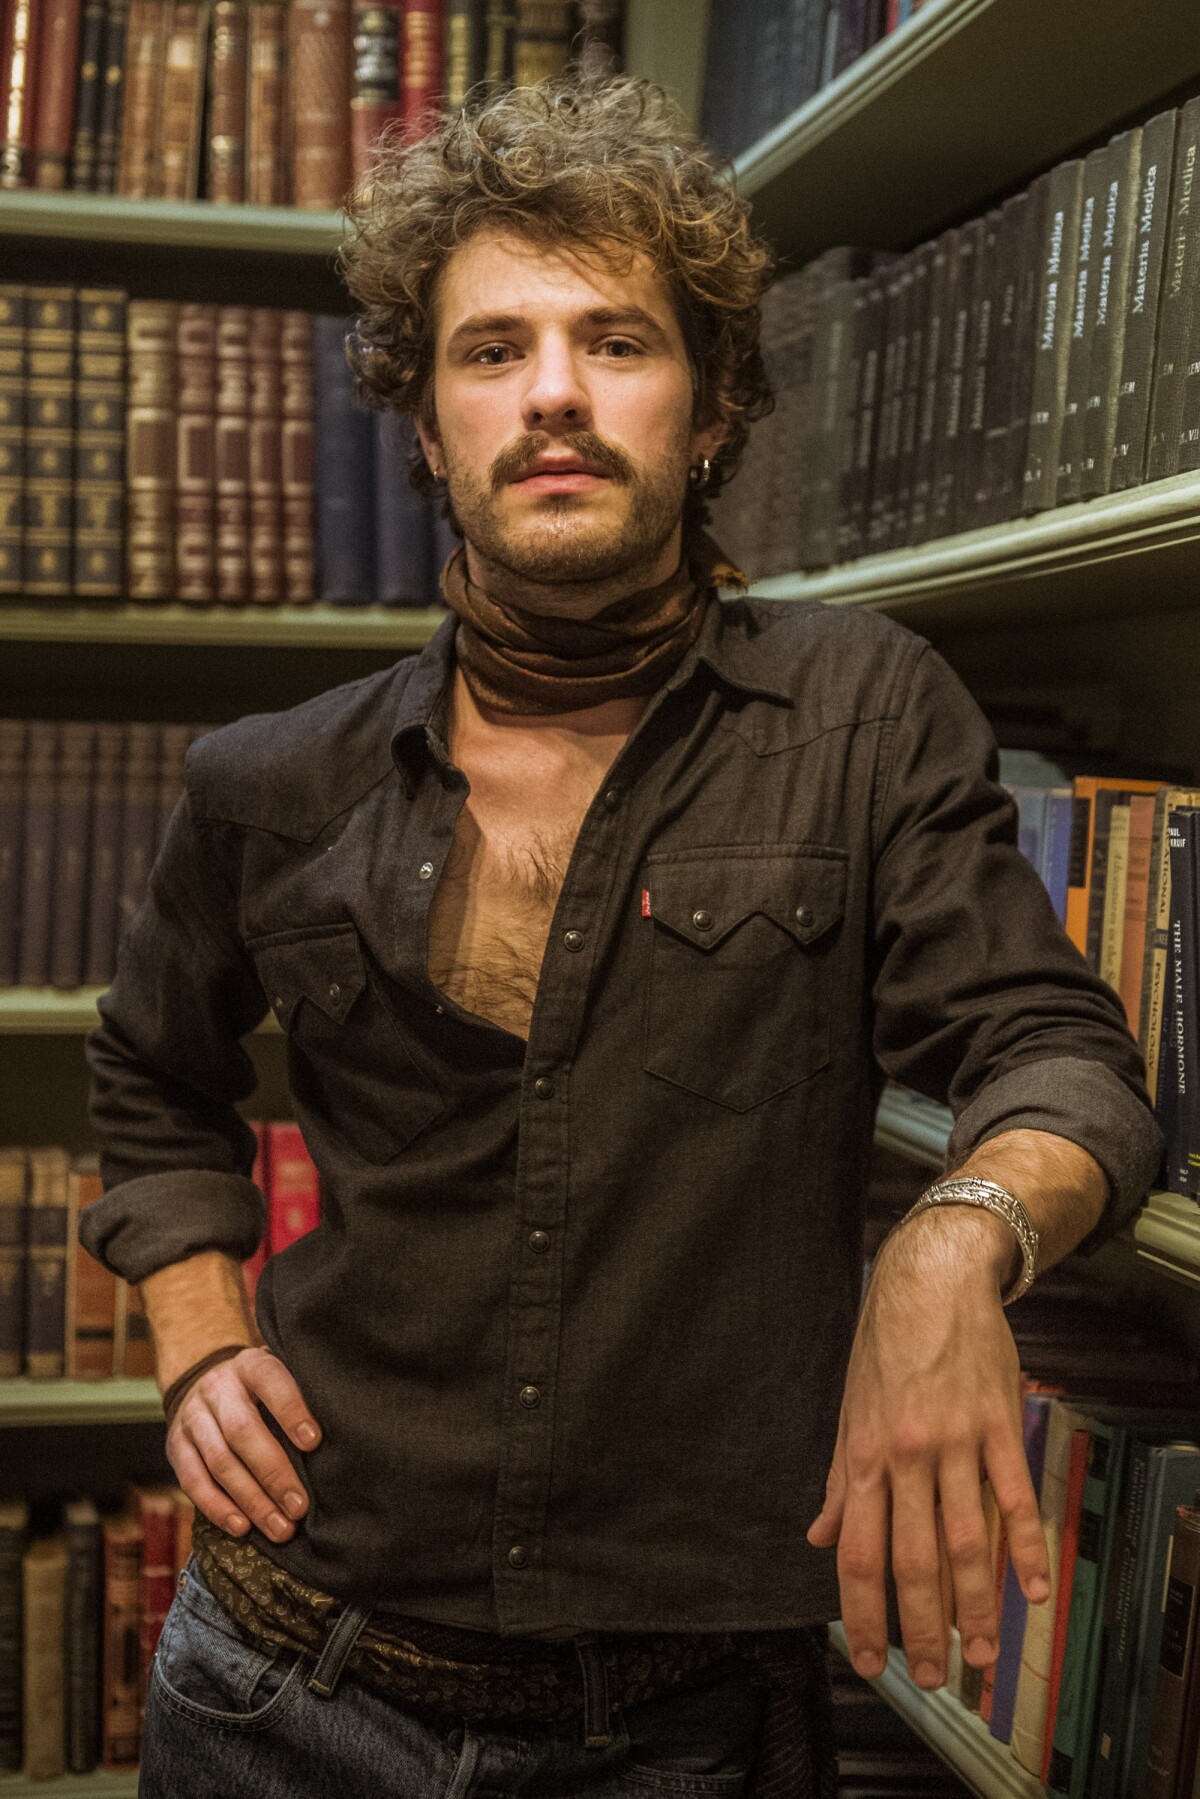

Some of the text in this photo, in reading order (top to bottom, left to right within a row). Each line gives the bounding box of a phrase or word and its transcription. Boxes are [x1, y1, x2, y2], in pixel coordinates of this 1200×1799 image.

[1132, 164, 1158, 314] Materia Medica
[1178, 144, 1197, 217] Medica
[1041, 211, 1064, 351] Materia Medica
[1073, 196, 1095, 339] Materia Medica
[1096, 181, 1119, 326] Materia Medica
[1148, 962, 1162, 1070] PSYCHOLOGY
[1173, 920, 1186, 1094] THE MALE HORMONE
